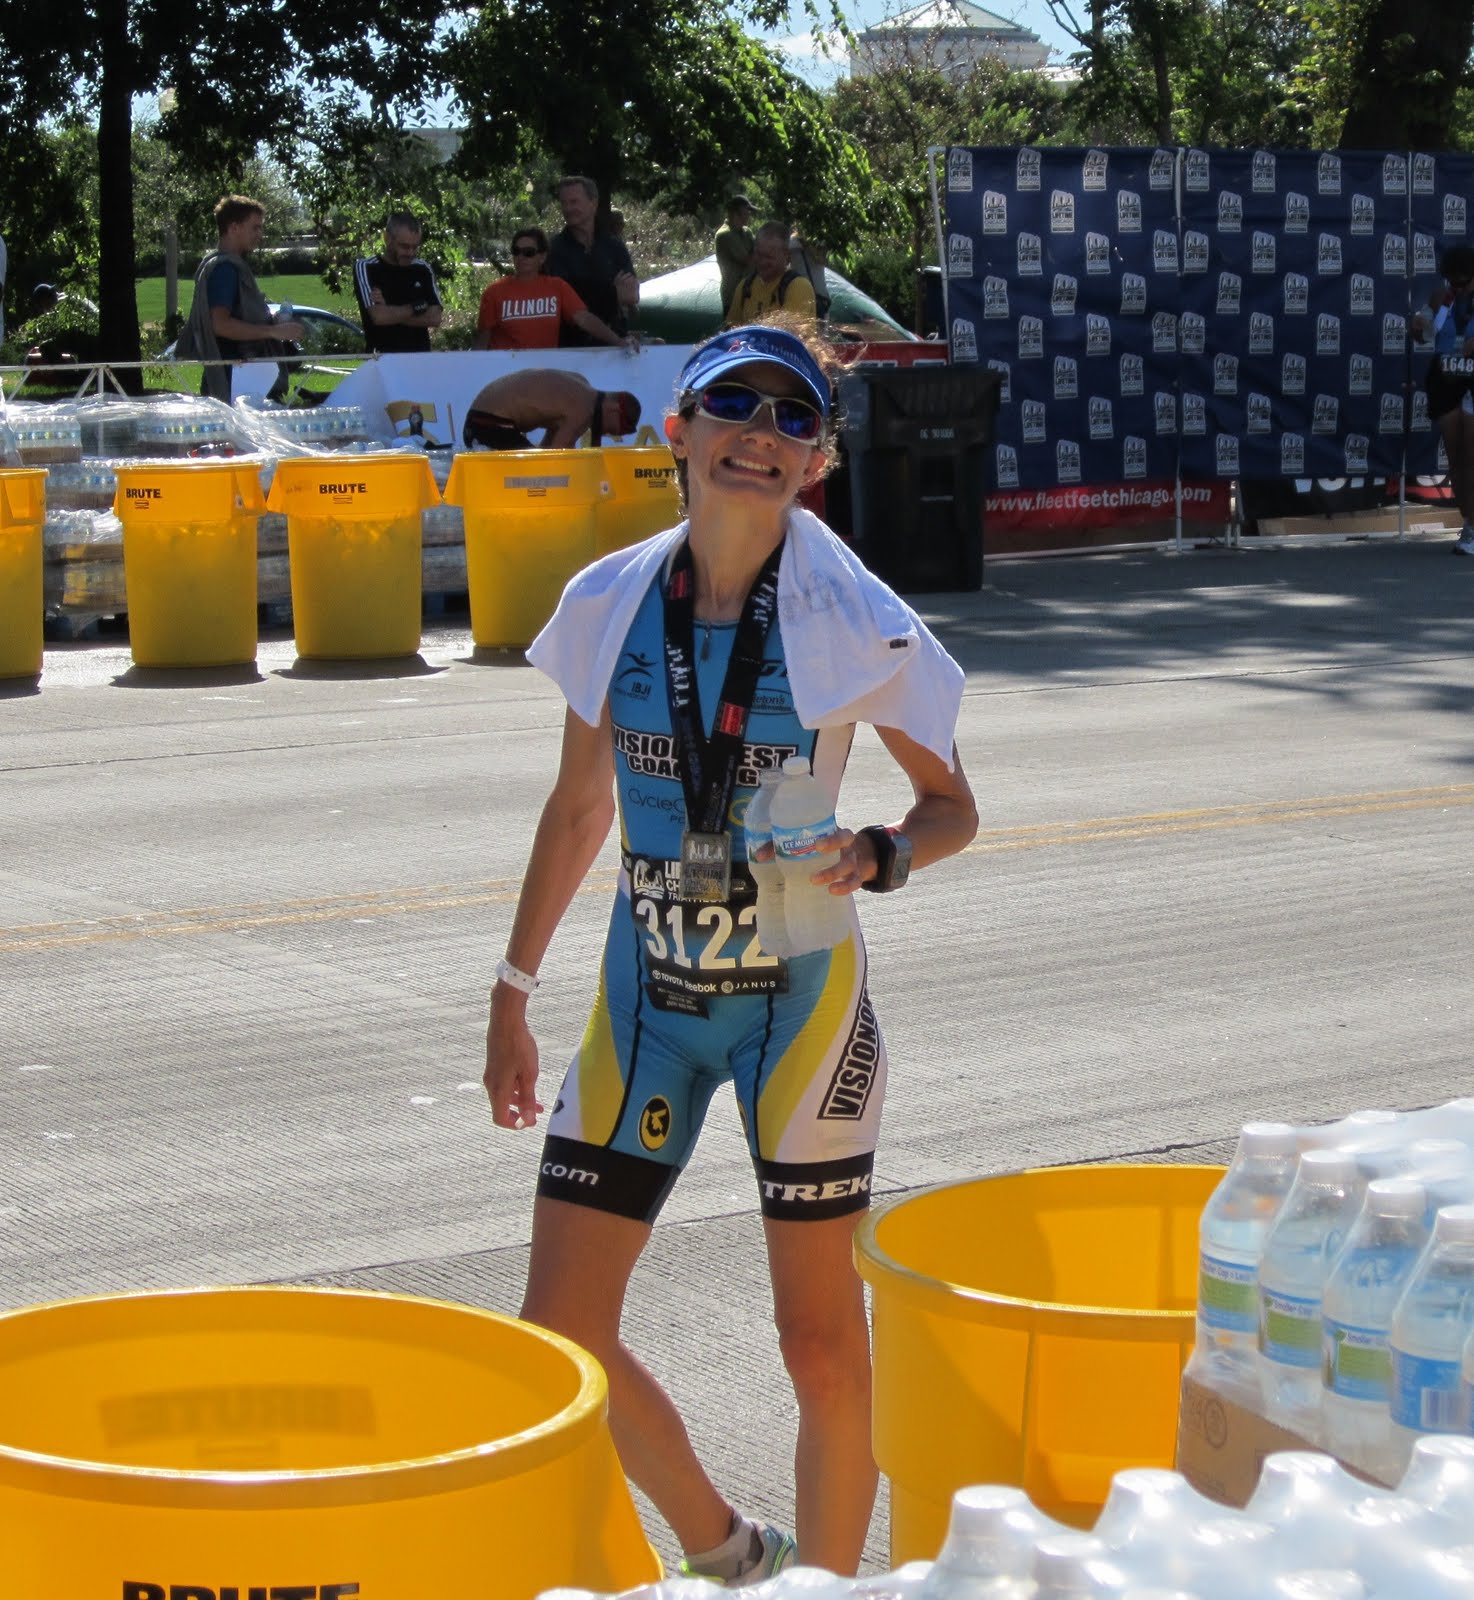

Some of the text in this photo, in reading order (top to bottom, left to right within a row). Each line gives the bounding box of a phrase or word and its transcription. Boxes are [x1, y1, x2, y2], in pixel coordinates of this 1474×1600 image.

[502, 296, 557, 318] ILLINOIS
[1441, 357, 1474, 373] 1648
[126, 488, 161, 499] BRUTE
[319, 483, 367, 495] BRUTE
[985, 486, 1212, 511] www.fleetfeetchicago.com
[636, 899, 779, 970] 3122
[661, 973, 776, 993] TOYOTA Reebok JANUS
[762, 1174, 872, 1202] TREK
